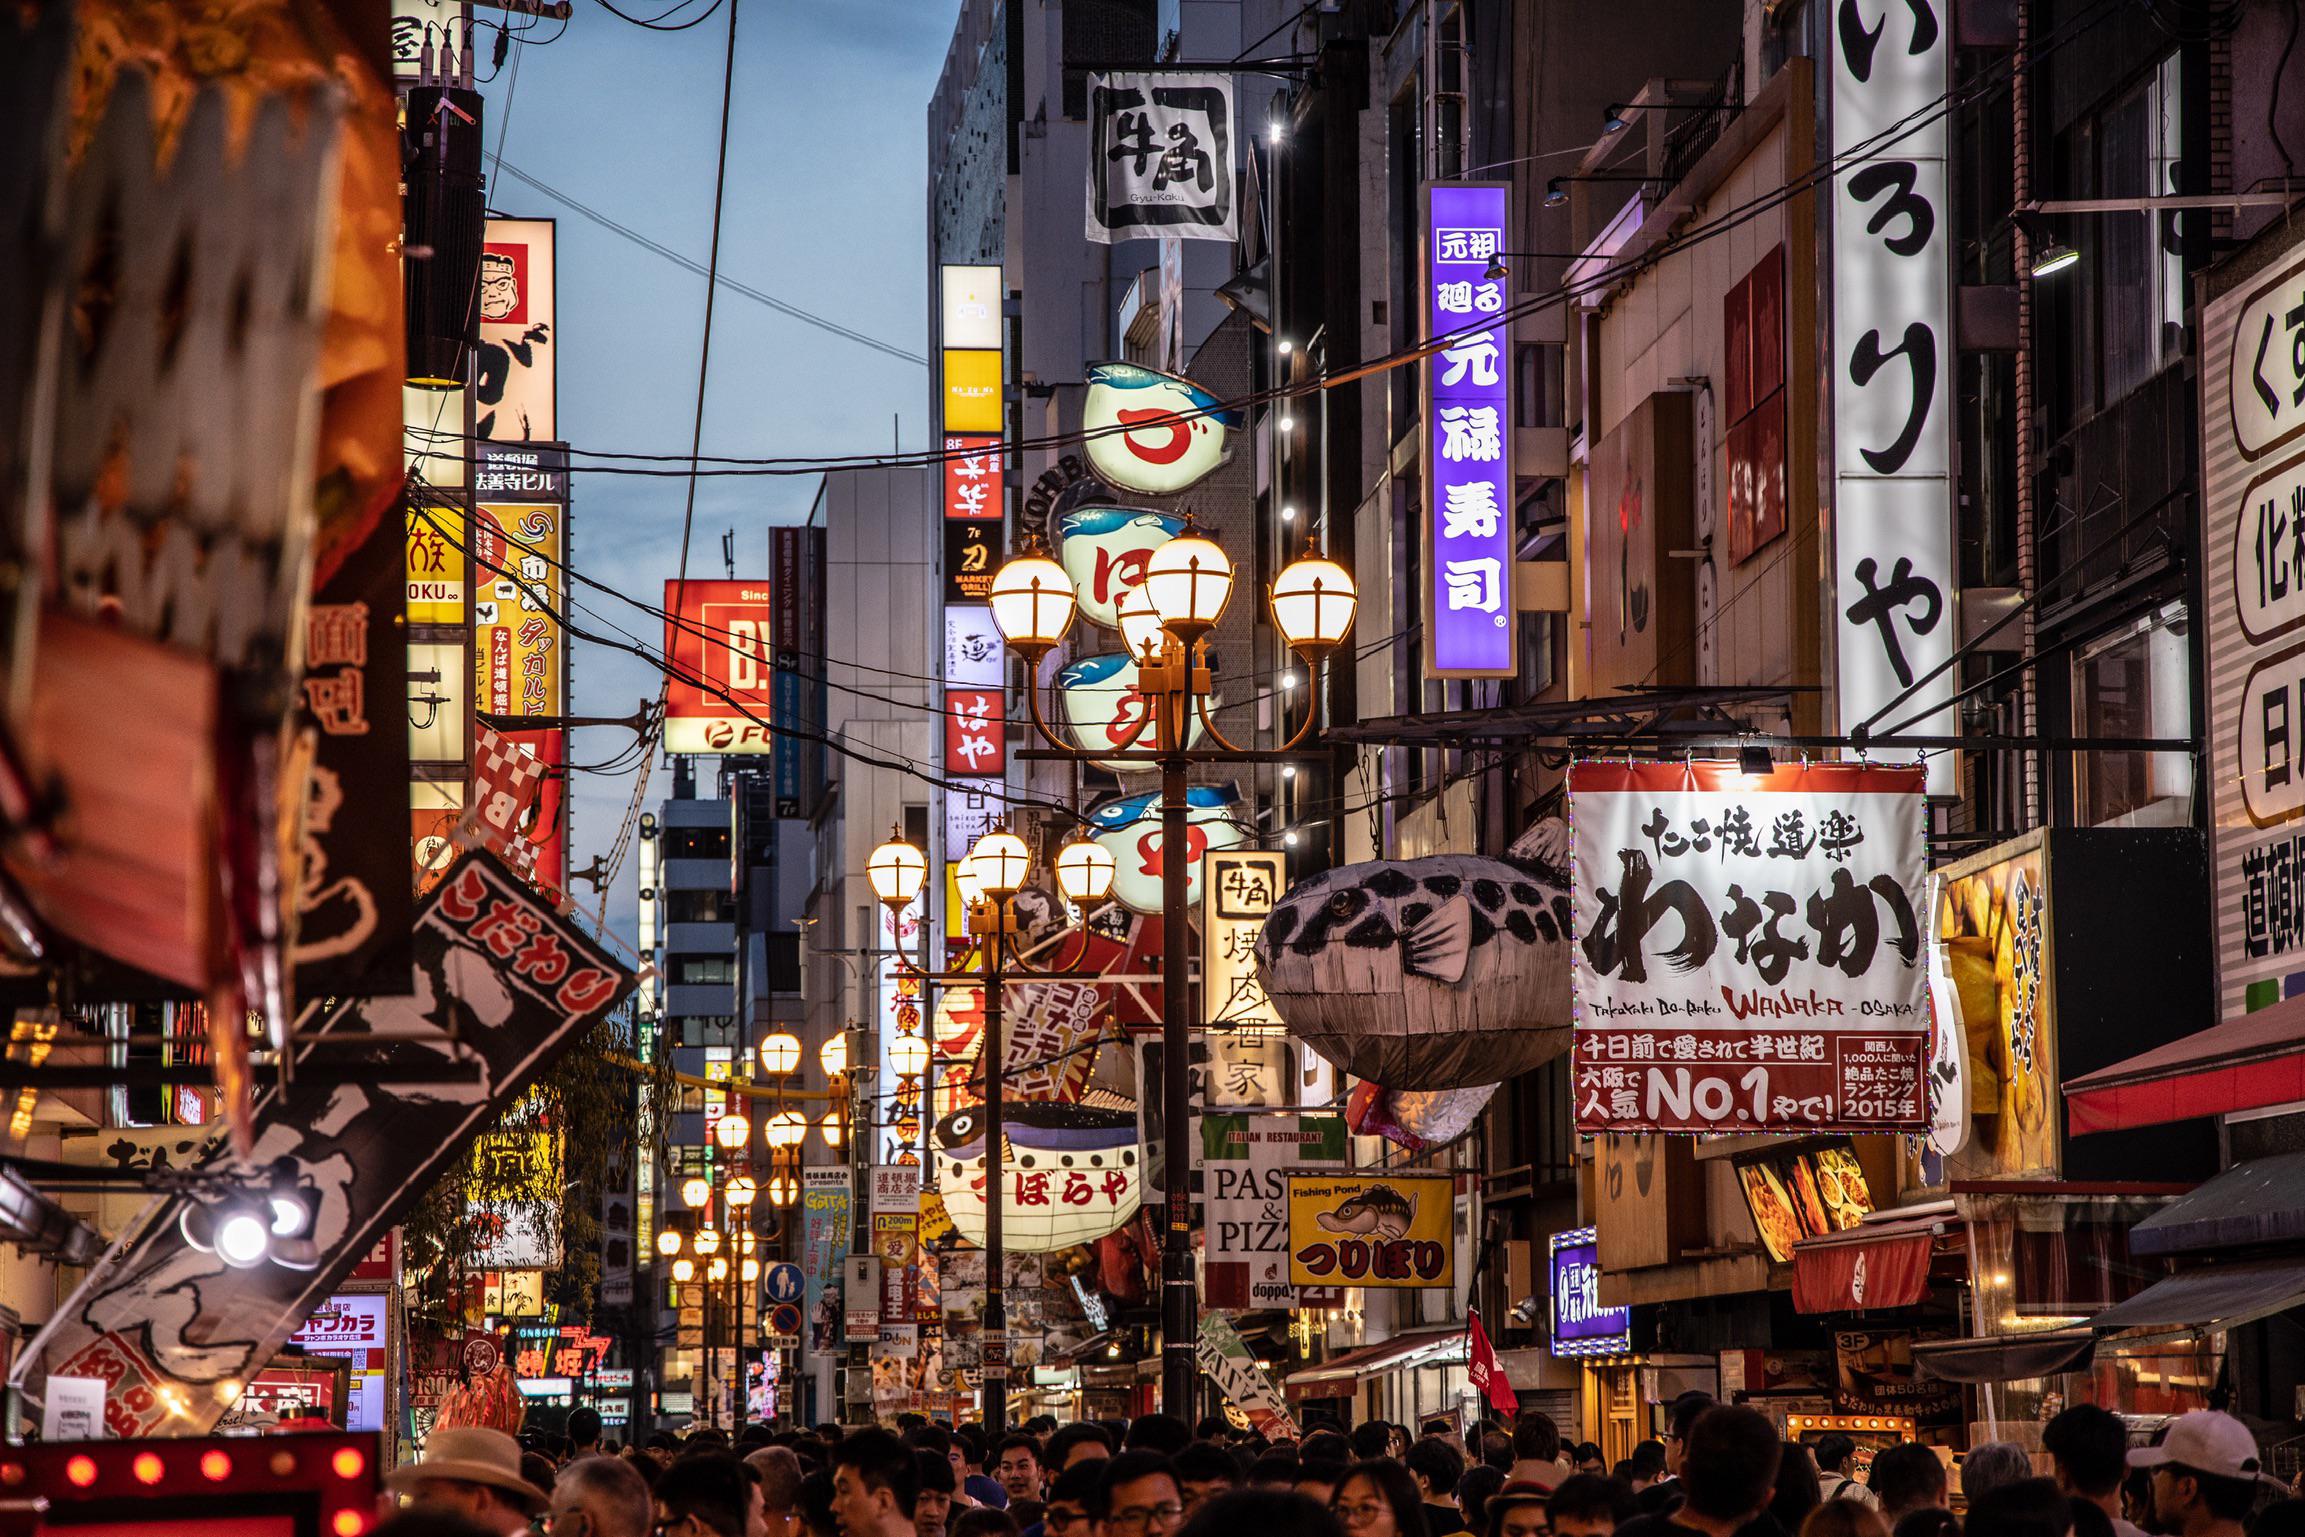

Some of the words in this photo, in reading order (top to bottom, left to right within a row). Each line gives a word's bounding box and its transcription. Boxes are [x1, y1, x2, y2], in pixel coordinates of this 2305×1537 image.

[1107, 111, 1215, 193] 牛角
[1441, 231, 1497, 260] 元祖
[946, 439, 962, 450] 8F
[1440, 331, 1502, 614] 元禄寿司
[967, 528, 981, 538] 7F
[954, 694, 996, 770] はや
[1641, 805, 1865, 867] たこ焼道楽
[1223, 871, 1270, 906] 牛角
[1582, 848, 1920, 986] わなか
[1581, 1033, 1826, 1060] 千日前で愛されて半世紀
[1864, 1041, 1897, 1053] 関西人
[1579, 1066, 1642, 1090] 大阪で
[1844, 1066, 1916, 1082] 絶品たこ焼
[1843, 1081, 1918, 1099] ランキング
[1844, 1100, 1917, 1119] 2015年
[1228, 1131, 1261, 1144] ITALIAN
[1266, 1131, 1323, 1144] RESTAURANT
[1293, 1185, 1331, 1199] Fishing
[1333, 1184, 1361, 1195] Pond
[1295, 1238, 1446, 1281] つりぼり
[1840, 1334, 1865, 1349] 3F
